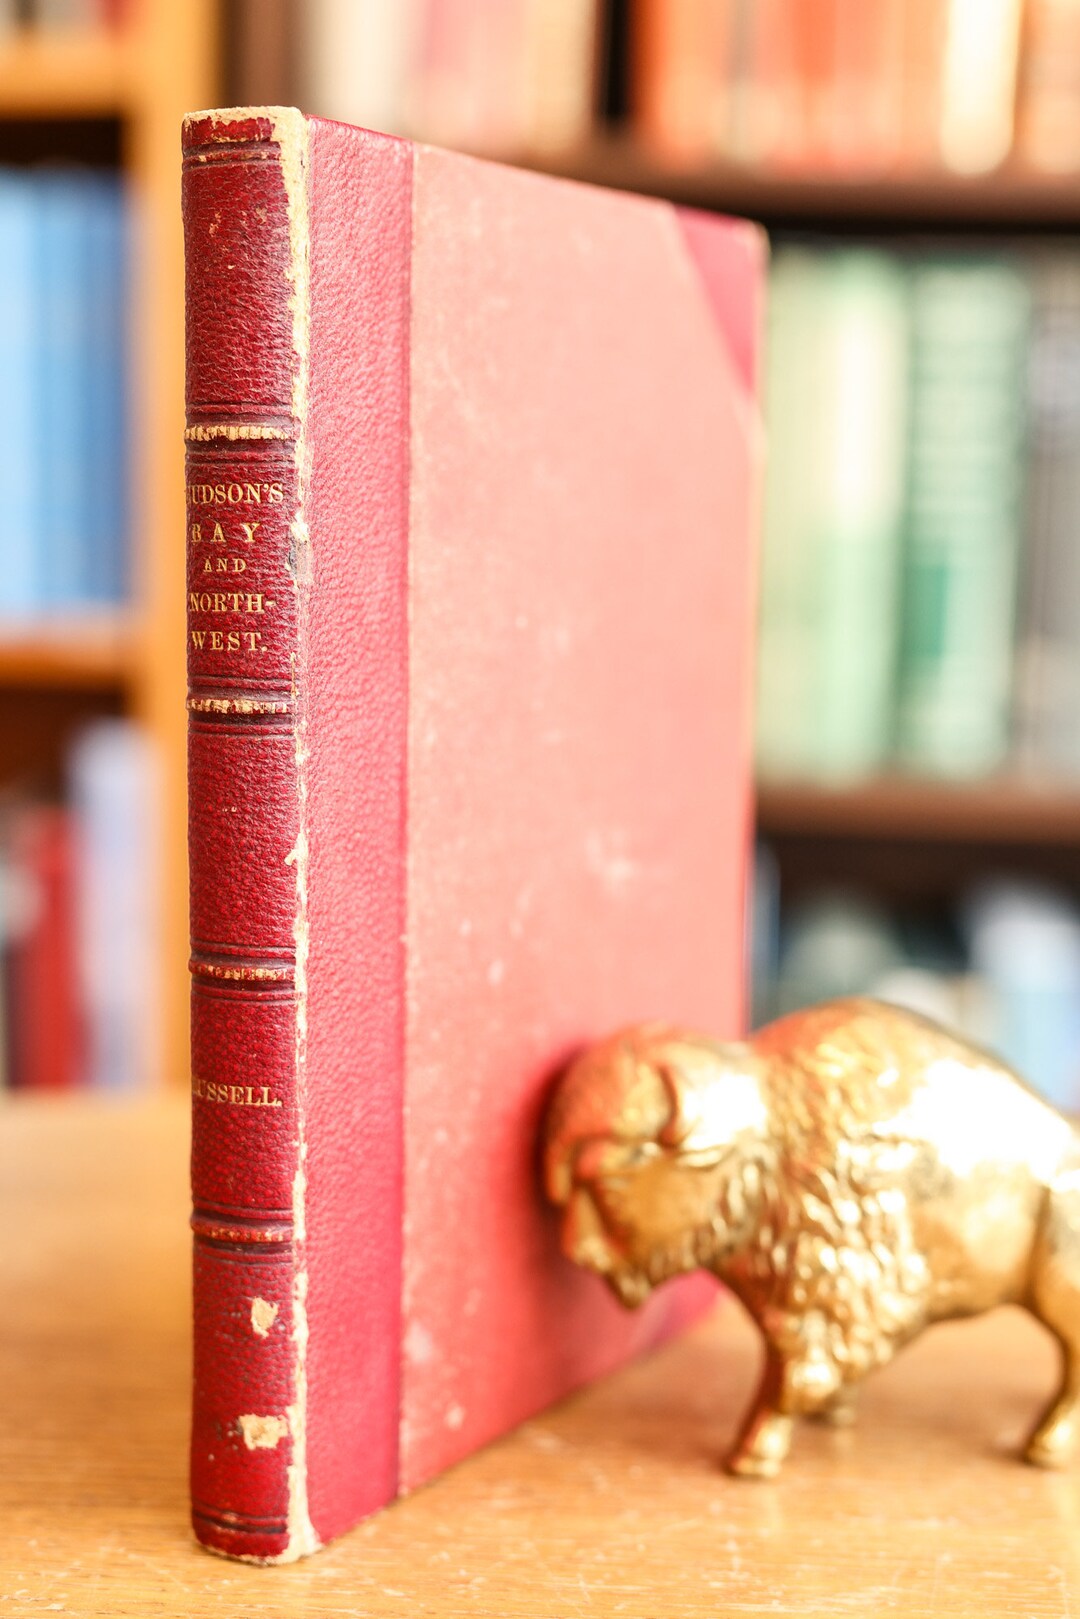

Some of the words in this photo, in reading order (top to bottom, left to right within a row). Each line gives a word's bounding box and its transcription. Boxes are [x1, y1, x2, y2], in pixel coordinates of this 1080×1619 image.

[203, 556, 247, 573] AND
[189, 592, 276, 613] NORTH-
[191, 631, 268, 652] WEST.
[192, 1079, 283, 1108] USSELL.
